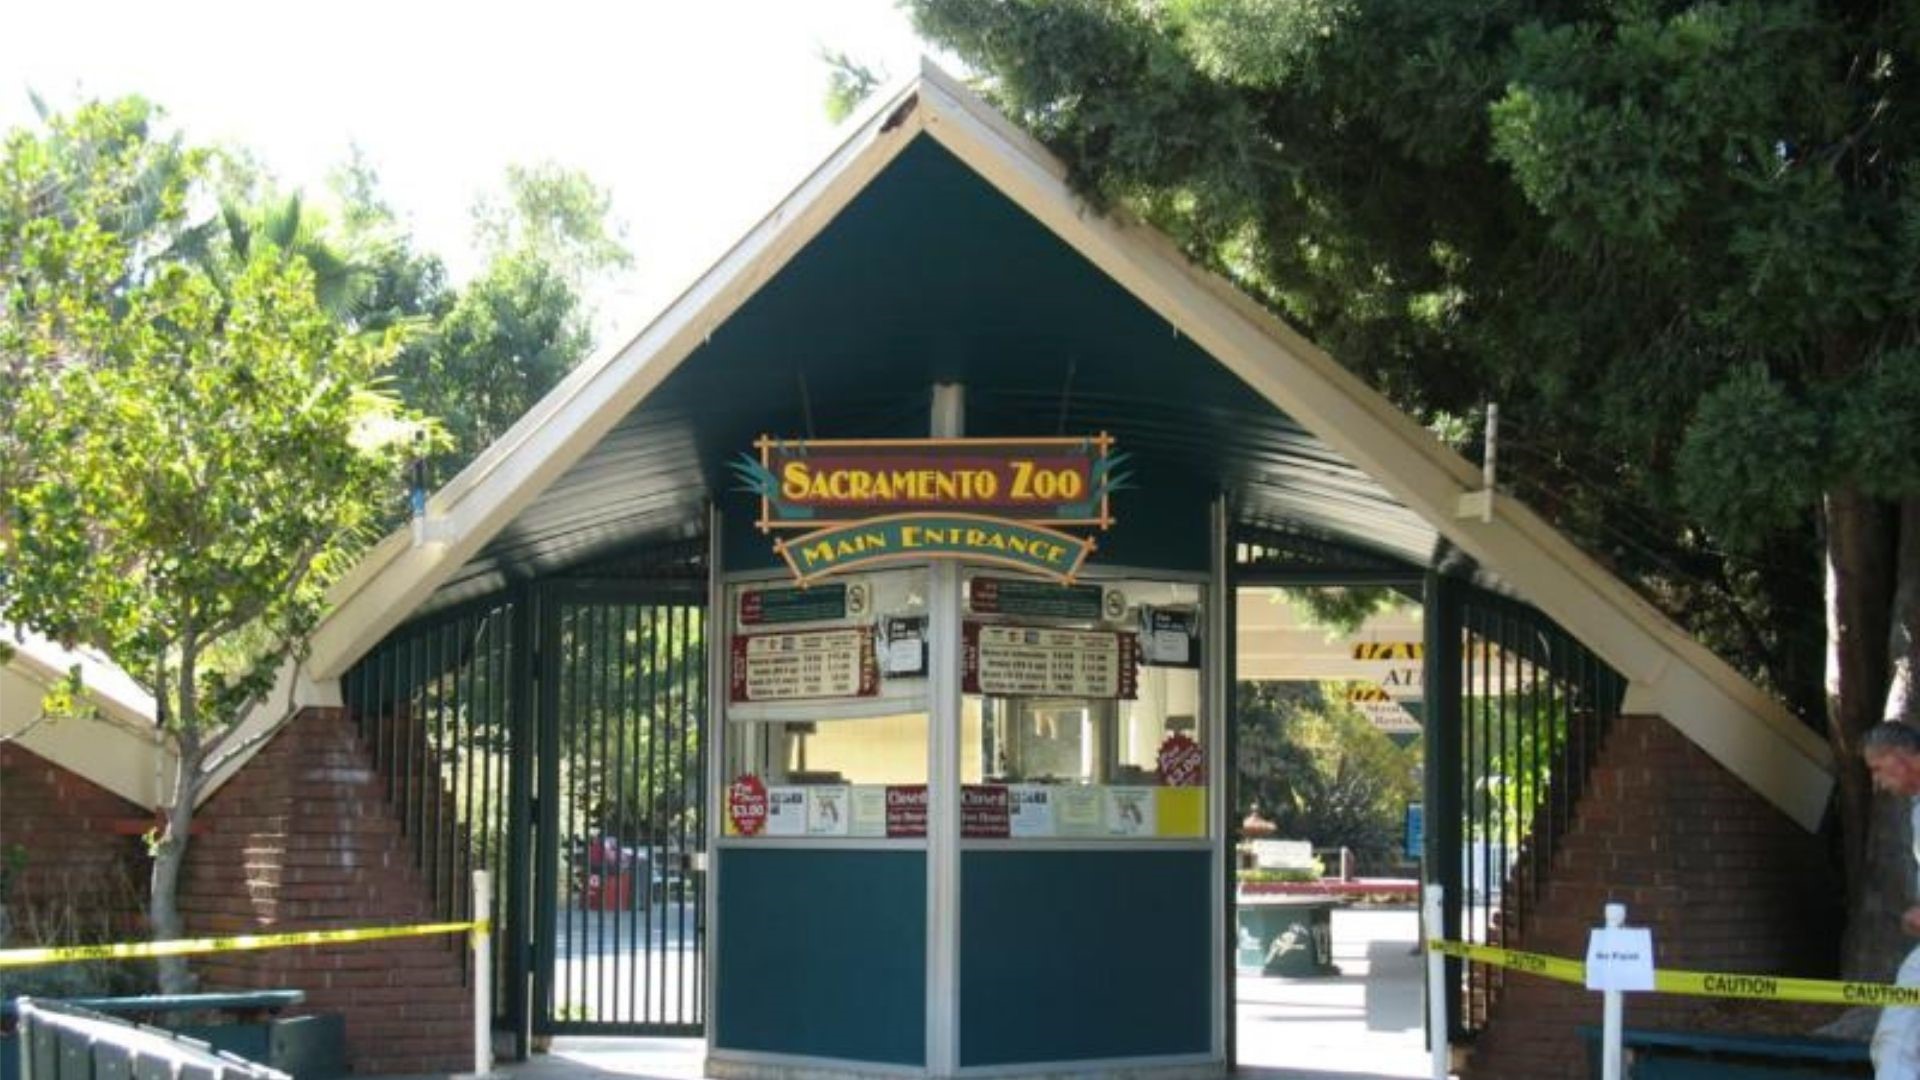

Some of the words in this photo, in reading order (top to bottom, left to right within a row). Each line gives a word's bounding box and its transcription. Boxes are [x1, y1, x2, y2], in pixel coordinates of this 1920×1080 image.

[782, 461, 997, 500] SACRAMENTO
[1008, 461, 1082, 499] ZOO
[803, 531, 887, 566] MAIN
[901, 526, 1067, 564] ENTRANCE
[1382, 668, 1424, 686] AT
[1703, 975, 1778, 995] CAUTION
[1843, 985, 1919, 1002] CAUTION
